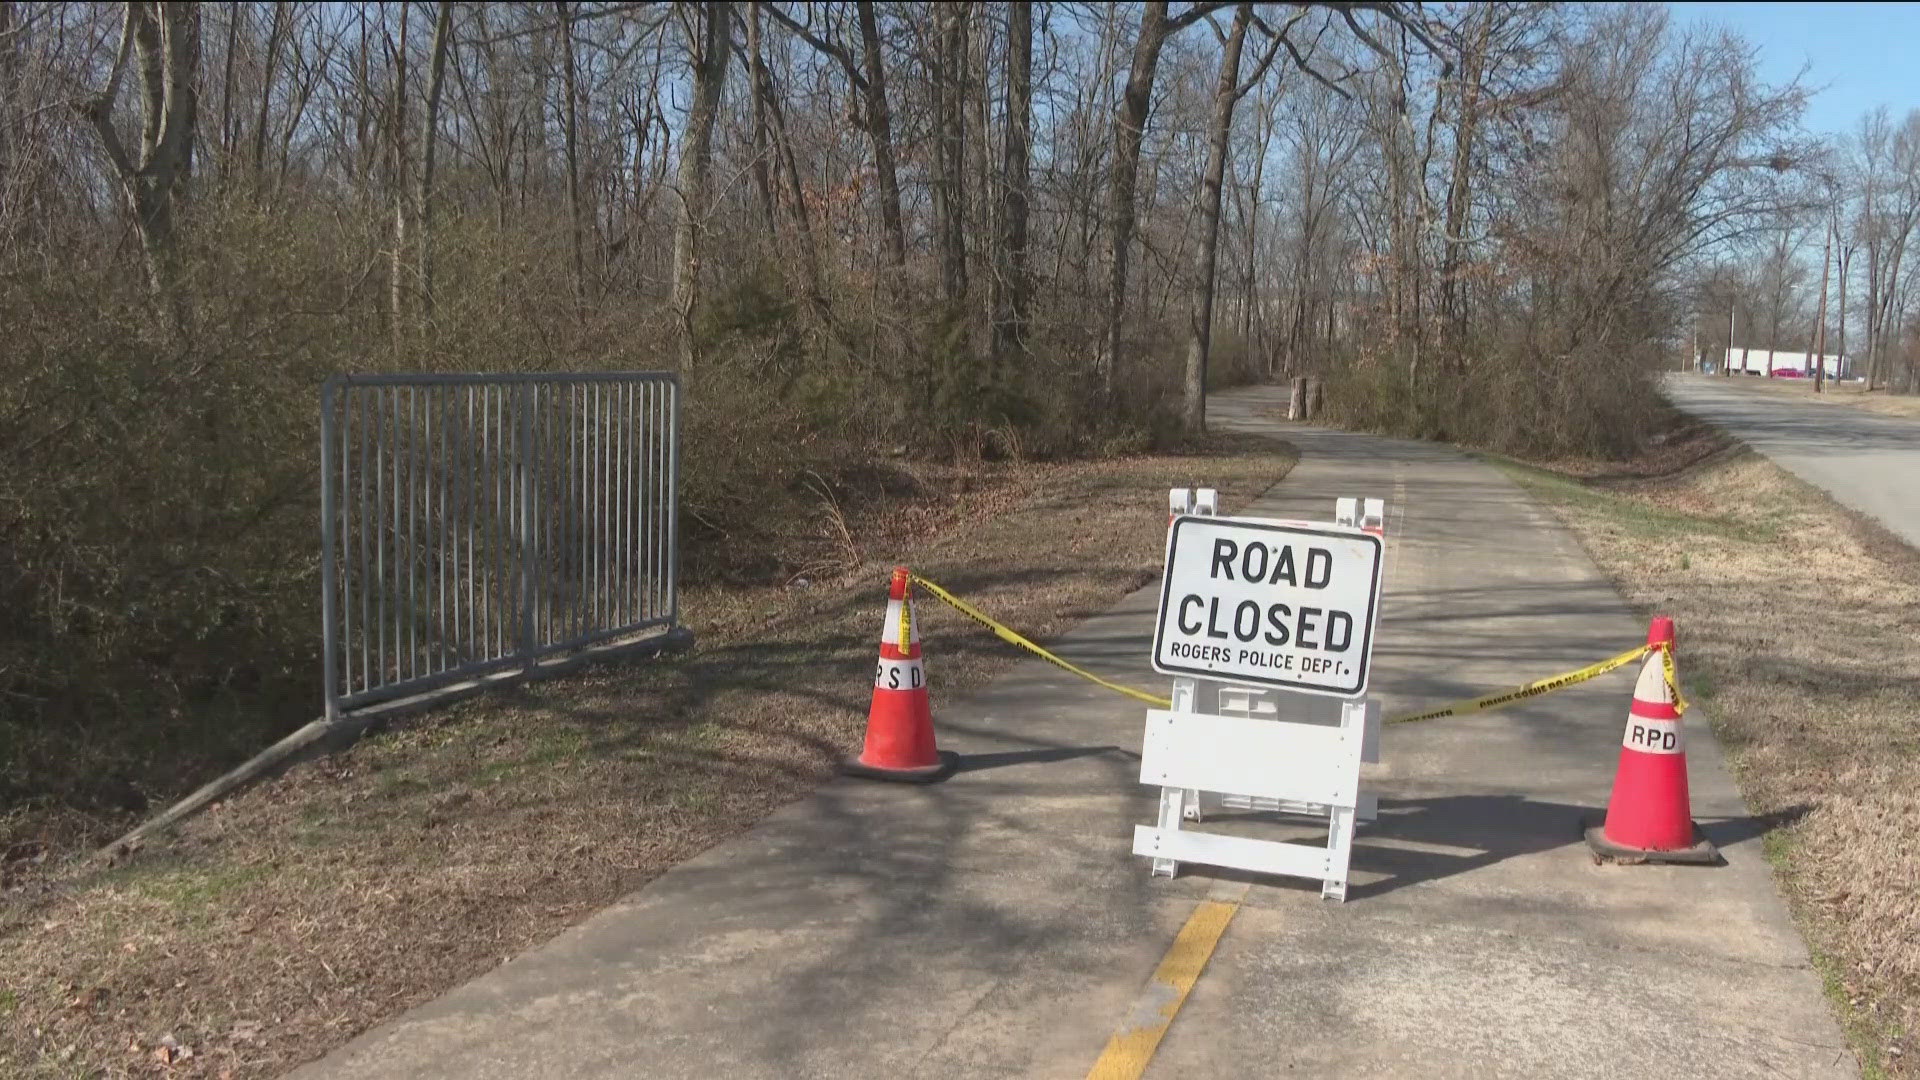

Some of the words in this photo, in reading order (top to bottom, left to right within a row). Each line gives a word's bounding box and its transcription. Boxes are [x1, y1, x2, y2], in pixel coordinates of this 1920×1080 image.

[1210, 537, 1333, 590] ROAD
[1177, 593, 1353, 653] CLOSED
[1170, 642, 1231, 663] ROGERS
[1238, 650, 1294, 670] POLICE
[1631, 725, 1676, 751] RPD
